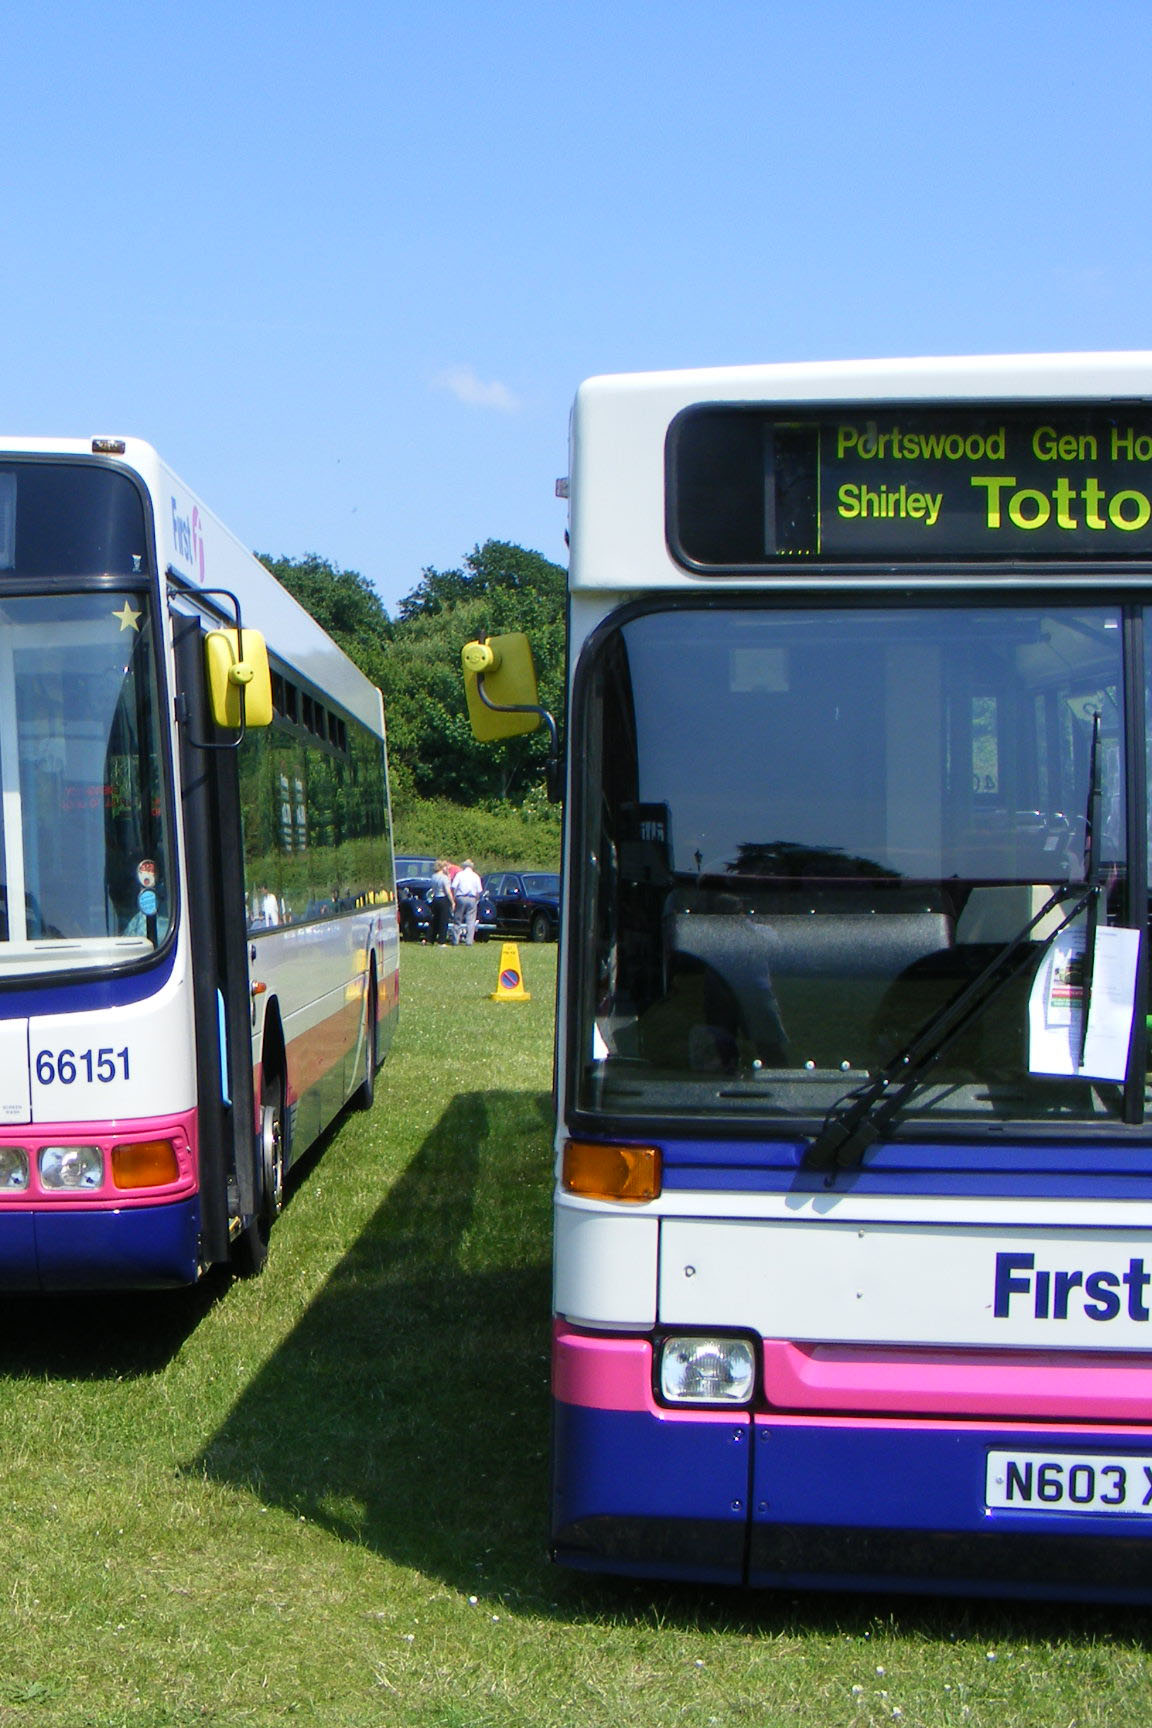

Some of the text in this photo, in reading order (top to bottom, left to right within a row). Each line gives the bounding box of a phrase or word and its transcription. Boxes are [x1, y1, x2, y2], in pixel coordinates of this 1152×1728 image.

[837, 426, 1152, 462] Portswood Gen Ho
[837, 483, 943, 526] Shirley
[970, 476, 1152, 532] Totto
[171, 495, 193, 566] First
[36, 1046, 130, 1085] 66151
[993, 1251, 1152, 1322] First
[1005, 1461, 1127, 1505] N603
